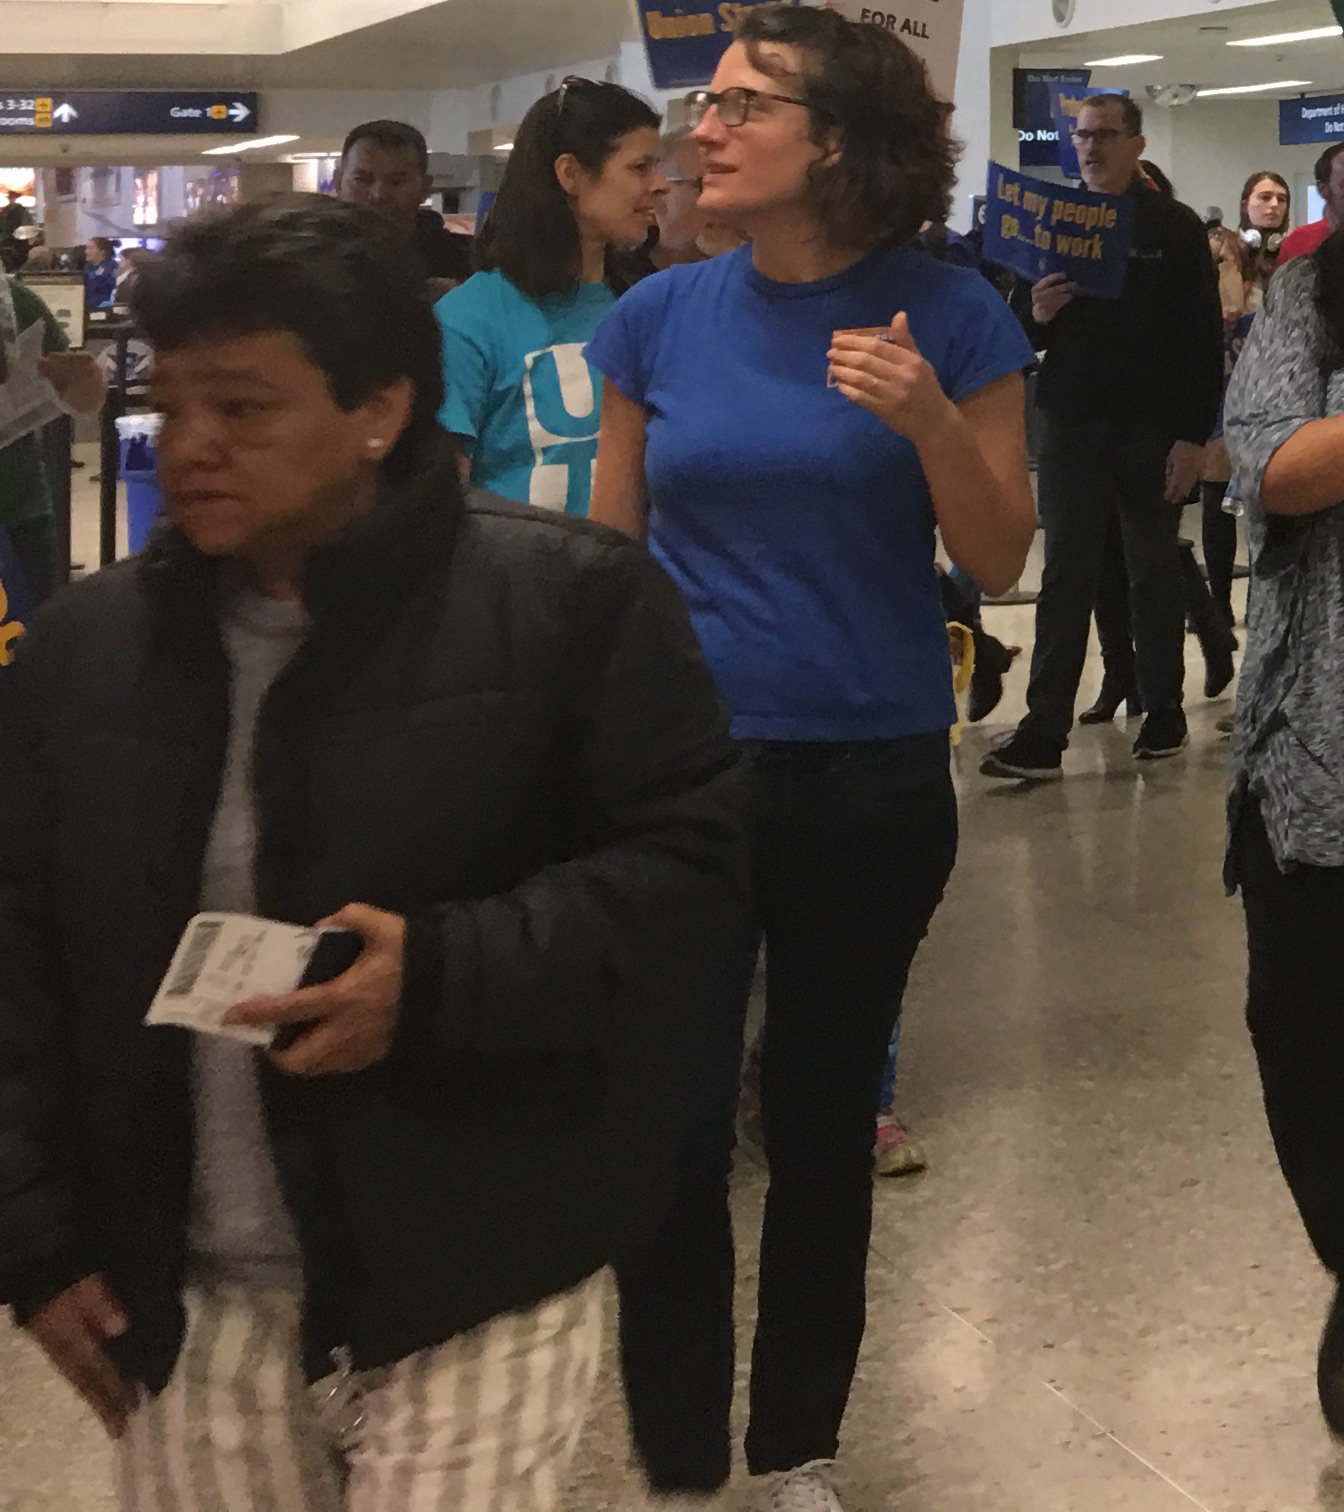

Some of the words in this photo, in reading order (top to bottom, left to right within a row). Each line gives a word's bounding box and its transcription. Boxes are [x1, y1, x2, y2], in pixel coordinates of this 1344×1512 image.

[861, 8, 897, 31] FOR
[900, 18, 930, 39] ALL
[997, 173, 1021, 206] Let
[1023, 191, 1049, 221] my
[1051, 201, 1118, 232] people
[1055, 233, 1104, 259] work
